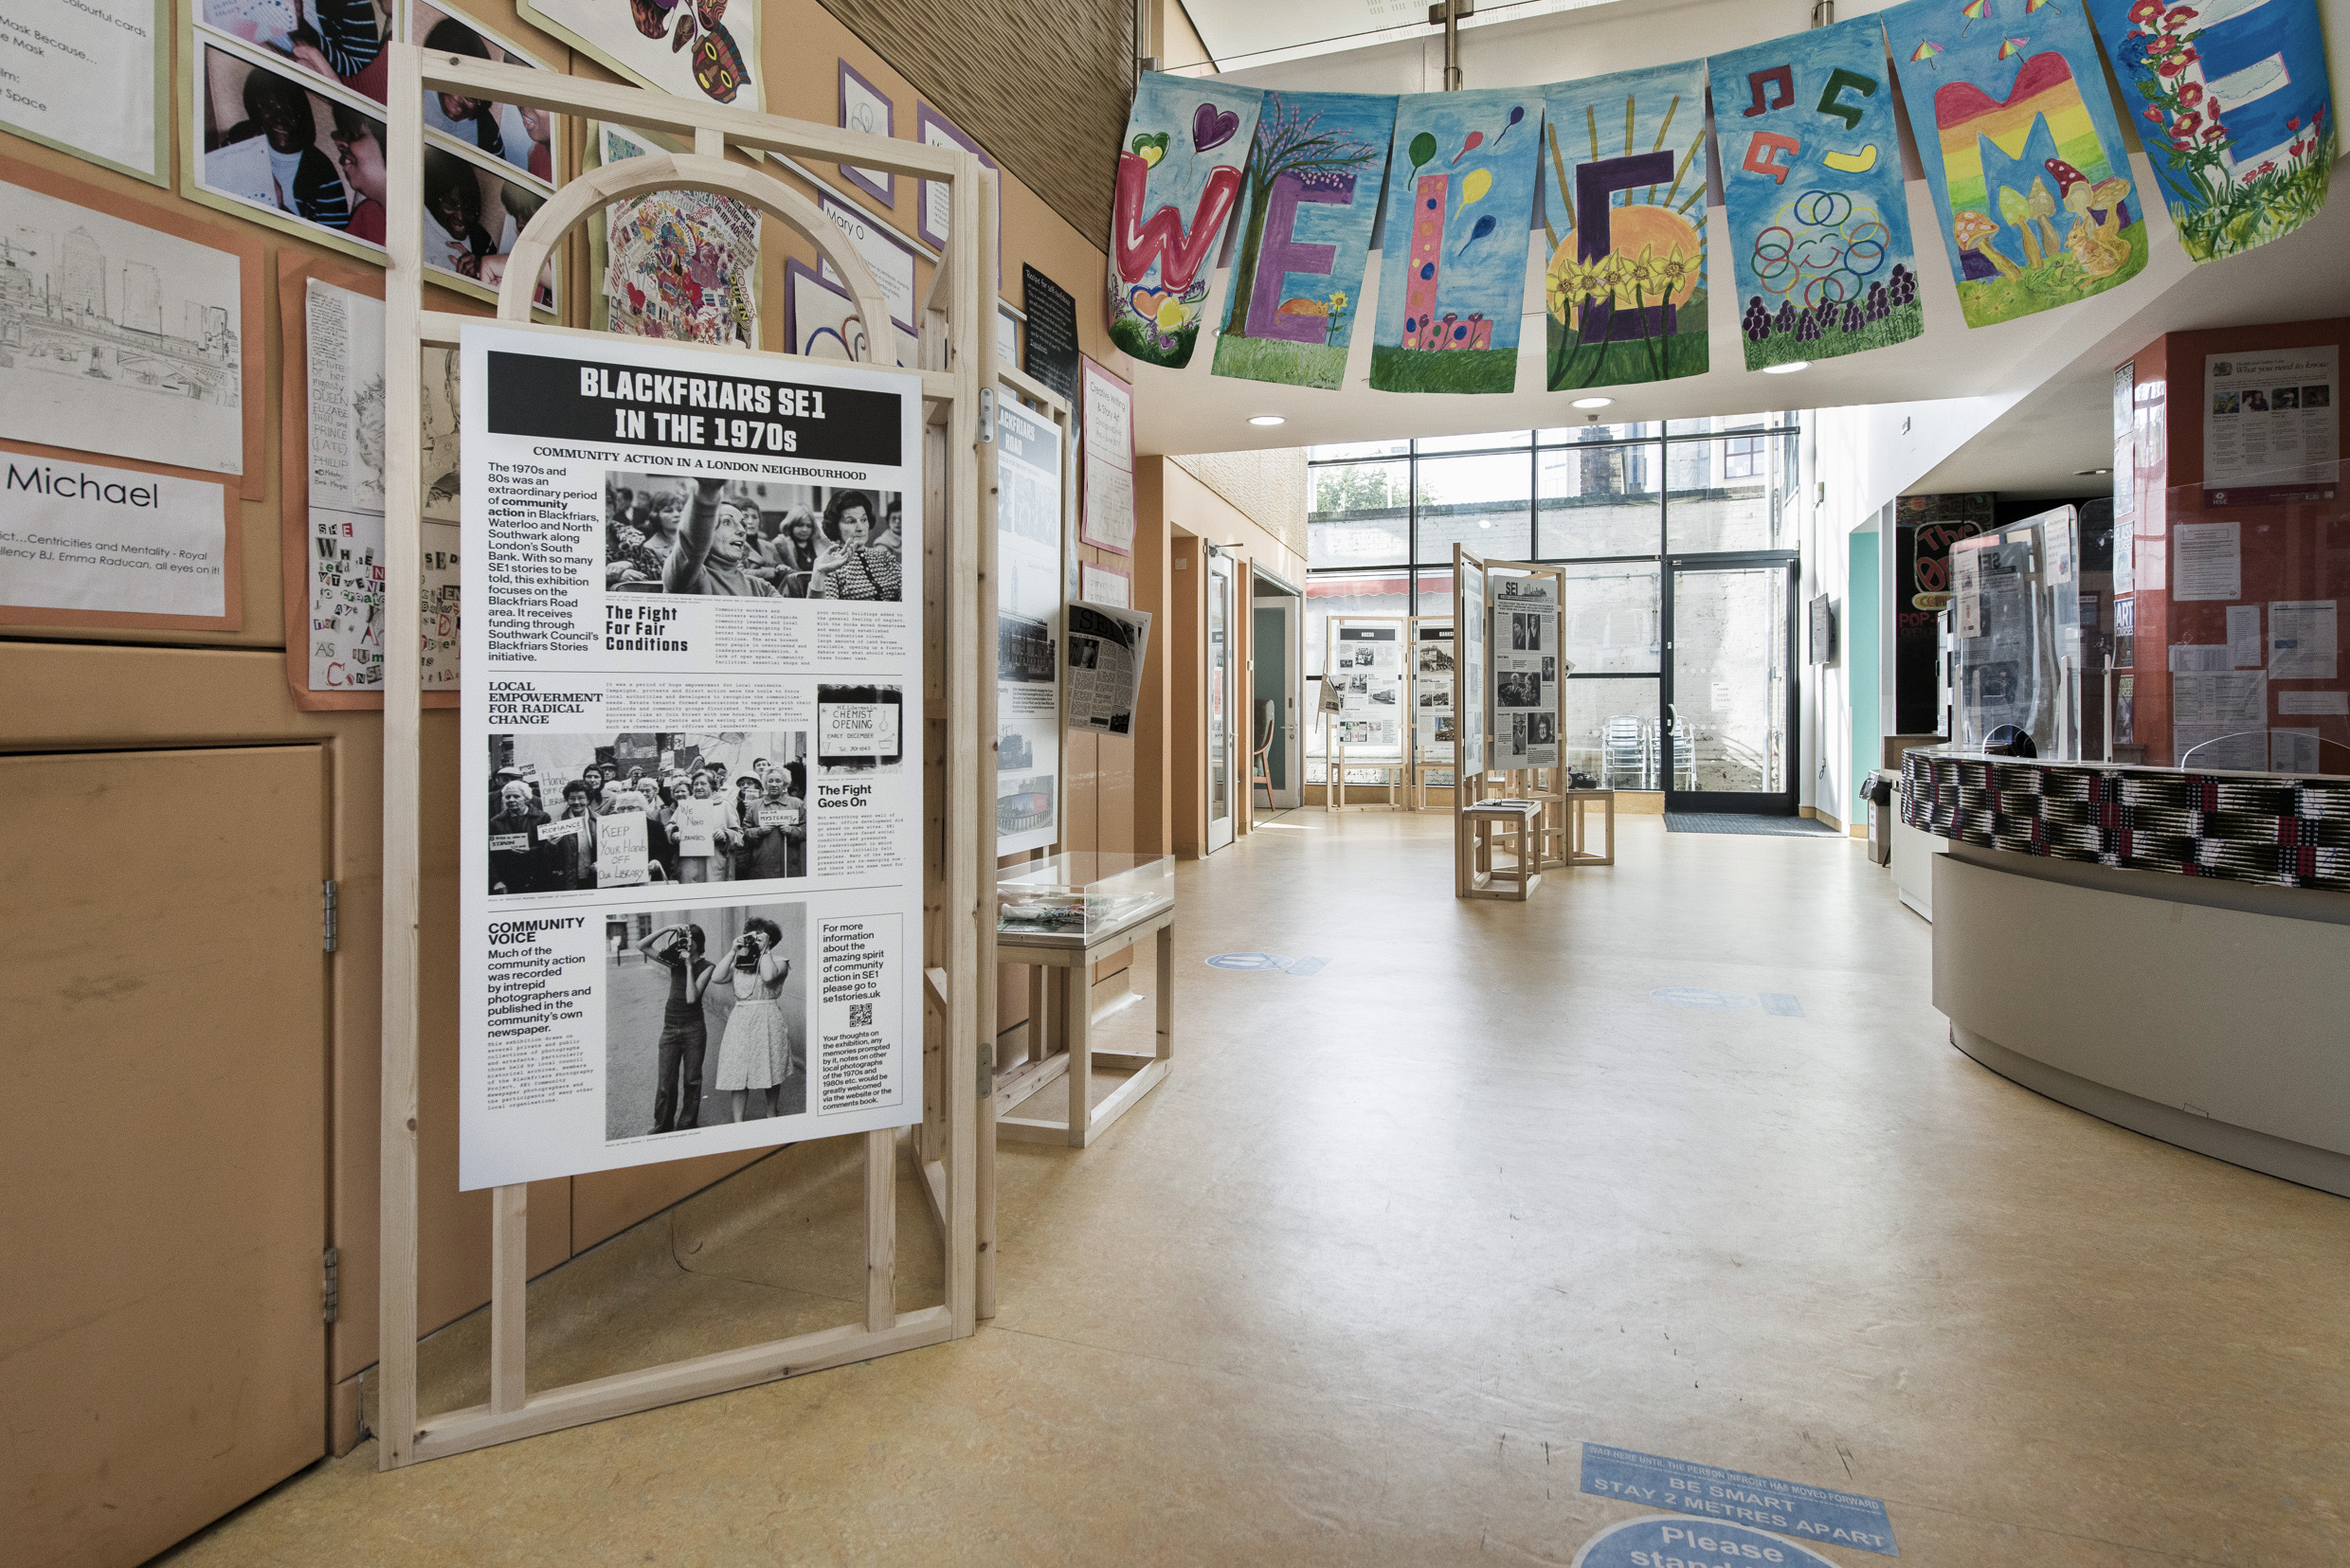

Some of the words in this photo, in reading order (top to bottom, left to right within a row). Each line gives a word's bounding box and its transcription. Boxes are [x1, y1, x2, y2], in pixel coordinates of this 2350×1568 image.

[115, 19, 147, 37] cards
[13, 37, 45, 57] Mask
[34, 30, 98, 64] Because...
[6, 88, 46, 112] Space
[826, 207, 854, 236] Mary
[730, 273, 750, 321] QUEEN
[734, 266, 757, 319] GODDESS
[2236, 365, 2256, 373] What
[2258, 366, 2273, 374] you
[313, 388, 349, 406] QUEEN
[581, 368, 770, 413] BLACKFRIARS
[779, 387, 825, 419] SE1
[1090, 381, 1111, 402] Creative
[1111, 393, 1126, 412] Writing
[314, 424, 347, 440] PRINCE
[616, 410, 645, 439] IN
[653, 414, 704, 444] THE
[714, 419, 796, 452] 1970s
[998, 408, 1036, 442] ACKFRIARS
[1004, 432, 1022, 457] ROAD
[488, 461, 510, 473] The
[512, 463, 545, 475] 1970s
[547, 467, 567, 477] and
[533, 446, 620, 462] COMMUNITY
[624, 453, 673, 466] ACTION
[678, 457, 691, 468] IN
[696, 459, 703, 469] A
[707, 460, 758, 473] LONDON
[763, 463, 866, 480] NEIGHBOURHOOD
[7, 462, 158, 509] Michael
[488, 473, 510, 484] 80s
[513, 477, 533, 485] was
[536, 478, 549, 486] an
[488, 484, 561, 500] extraordinary
[564, 489, 597, 501] period
[488, 495, 498, 505] of
[502, 497, 568, 512] community
[489, 507, 525, 518] action
[528, 508, 536, 518] in
[539, 509, 599, 525] Blackfriars,
[489, 516, 538, 529] Waterloo
[540, 520, 560, 531] and
[563, 520, 592, 532] North
[489, 528, 548, 541] Southwark
[551, 532, 579, 546] along
[96, 541, 118, 552] and
[121, 544, 171, 559] Mentality
[179, 550, 208, 561] Royal
[489, 539, 538, 551] London's
[541, 542, 572, 553] South
[39, 550, 55, 561] BJ,
[59, 552, 96, 564] Emma
[99, 555, 152, 569] Raducan,
[155, 561, 167, 570] all
[170, 563, 193, 574] eyes
[211, 566, 220, 575] it!
[489, 550, 519, 562] Bank.
[522, 552, 547, 563] With
[550, 555, 562, 564] so
[565, 556, 592, 568] many
[489, 562, 508, 572] SE1
[512, 563, 548, 574] stories
[551, 564, 561, 574] to
[564, 565, 577, 574] be
[489, 573, 512, 586] told,
[515, 574, 534, 585] this
[537, 575, 588, 586] exhibition
[489, 585, 532, 595] focuses
[551, 586, 568, 596] the
[489, 596, 548, 607] Blackfriars
[551, 597, 577, 607] Road
[605, 605, 632, 620] The
[639, 606, 677, 623] Fight
[2116, 601, 2134, 627] ART
[606, 621, 630, 635] For
[636, 622, 664, 636] Fair
[606, 637, 687, 652] Conditions
[488, 682, 535, 692] LOCAL
[488, 693, 604, 702] EMPOWERMENT
[488, 704, 517, 713] FOR
[522, 704, 585, 713] RADICAL
[833, 710, 874, 719] CHEMIST
[488, 714, 550, 725] CHANGE
[832, 720, 874, 730] OPENING
[818, 785, 841, 795] The
[842, 784, 872, 796] Fight
[818, 798, 848, 808] Goes
[850, 797, 867, 807] On
[541, 820, 581, 835] ROMANCE
[601, 824, 630, 838] KEEP
[611, 855, 631, 865] OFF
[614, 868, 645, 882] LIBRARY
[488, 916, 586, 934] COMMUNITY
[488, 931, 536, 946] VOICE
[1588, 1445, 1611, 1458] WAIT
[1614, 1451, 1636, 1463] HERE
[1639, 1455, 1665, 1469] UNTIL
[1668, 1461, 1685, 1472] THE
[1688, 1465, 1724, 1480] PERSON
[1727, 1472, 1765, 1488] INFRONT
[1770, 1481, 1788, 1492] HAS
[1792, 1486, 1826, 1500] MOVED
[1829, 1492, 1878, 1510] FORWARD
[1670, 1477, 1704, 1493] BE
[1708, 1483, 1796, 1512] SMART
[1594, 1478, 1656, 1500] STAY
[1664, 1491, 1677, 1505] 2
[1684, 1496, 1787, 1527] METRES
[1796, 1519, 1885, 1548] APART
[1660, 1525, 1784, 1563] Please
